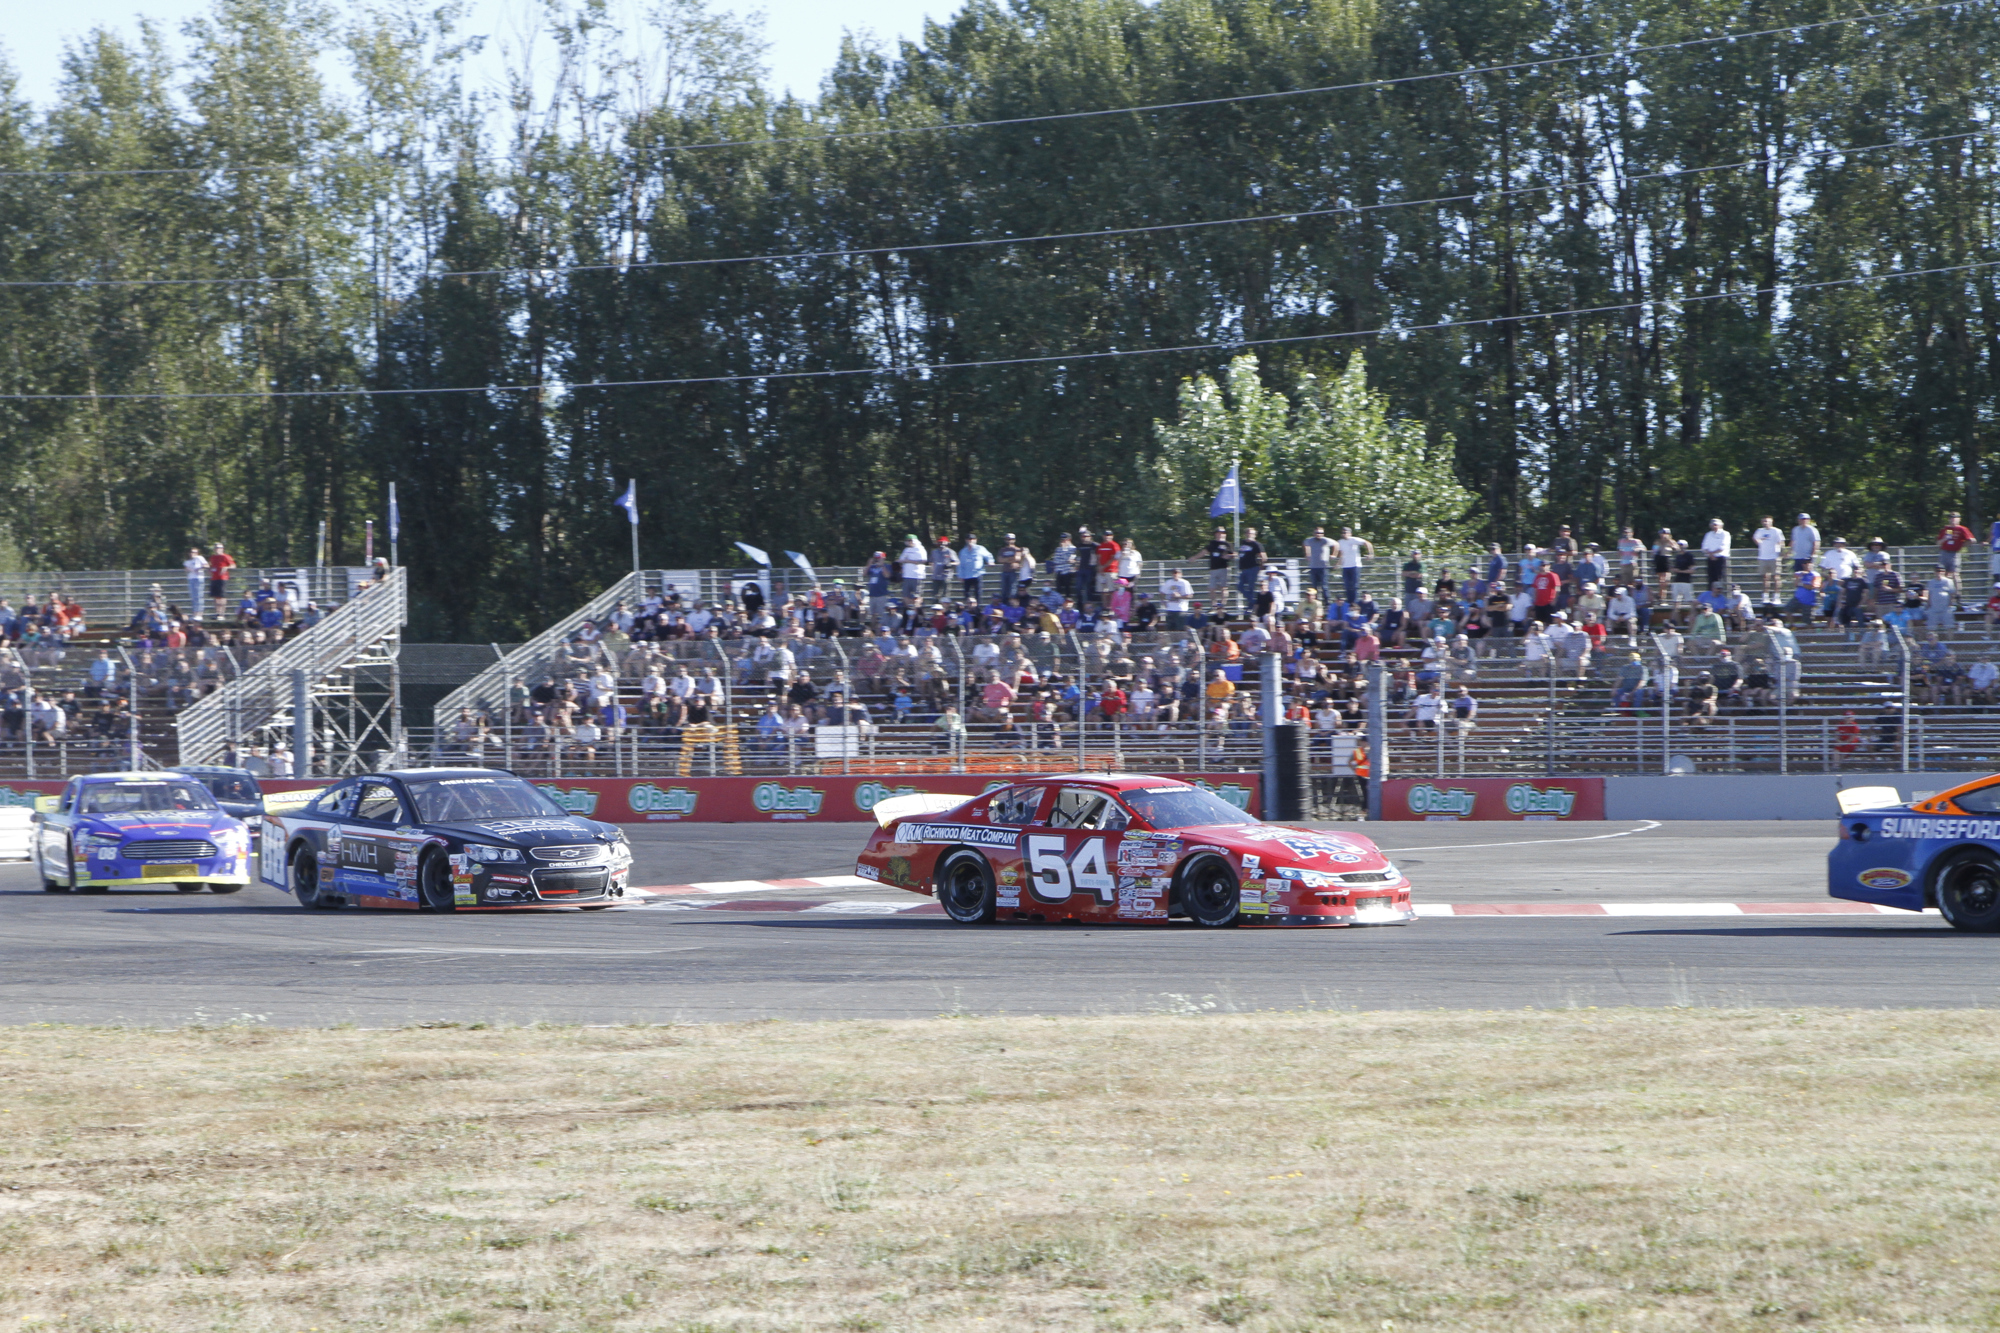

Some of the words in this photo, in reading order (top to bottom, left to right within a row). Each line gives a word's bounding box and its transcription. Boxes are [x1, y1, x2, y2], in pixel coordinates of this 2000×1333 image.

[629, 784, 697, 814] O'Reilly
[753, 783, 823, 813] O'Reilly
[1408, 784, 1475, 815] O'Reilly
[1506, 783, 1575, 815] O'Reilly
[907, 825, 923, 841] RM
[923, 825, 959, 839] RICHWOOD
[960, 826, 981, 841] MEAT
[981, 828, 1018, 844] COMPANY
[98, 847, 118, 861] 08
[340, 842, 378, 865] HMH
[342, 873, 380, 883] CONSTRUCTION
[1024, 834, 1116, 904] 54
[1304, 877, 1328, 887] 54
